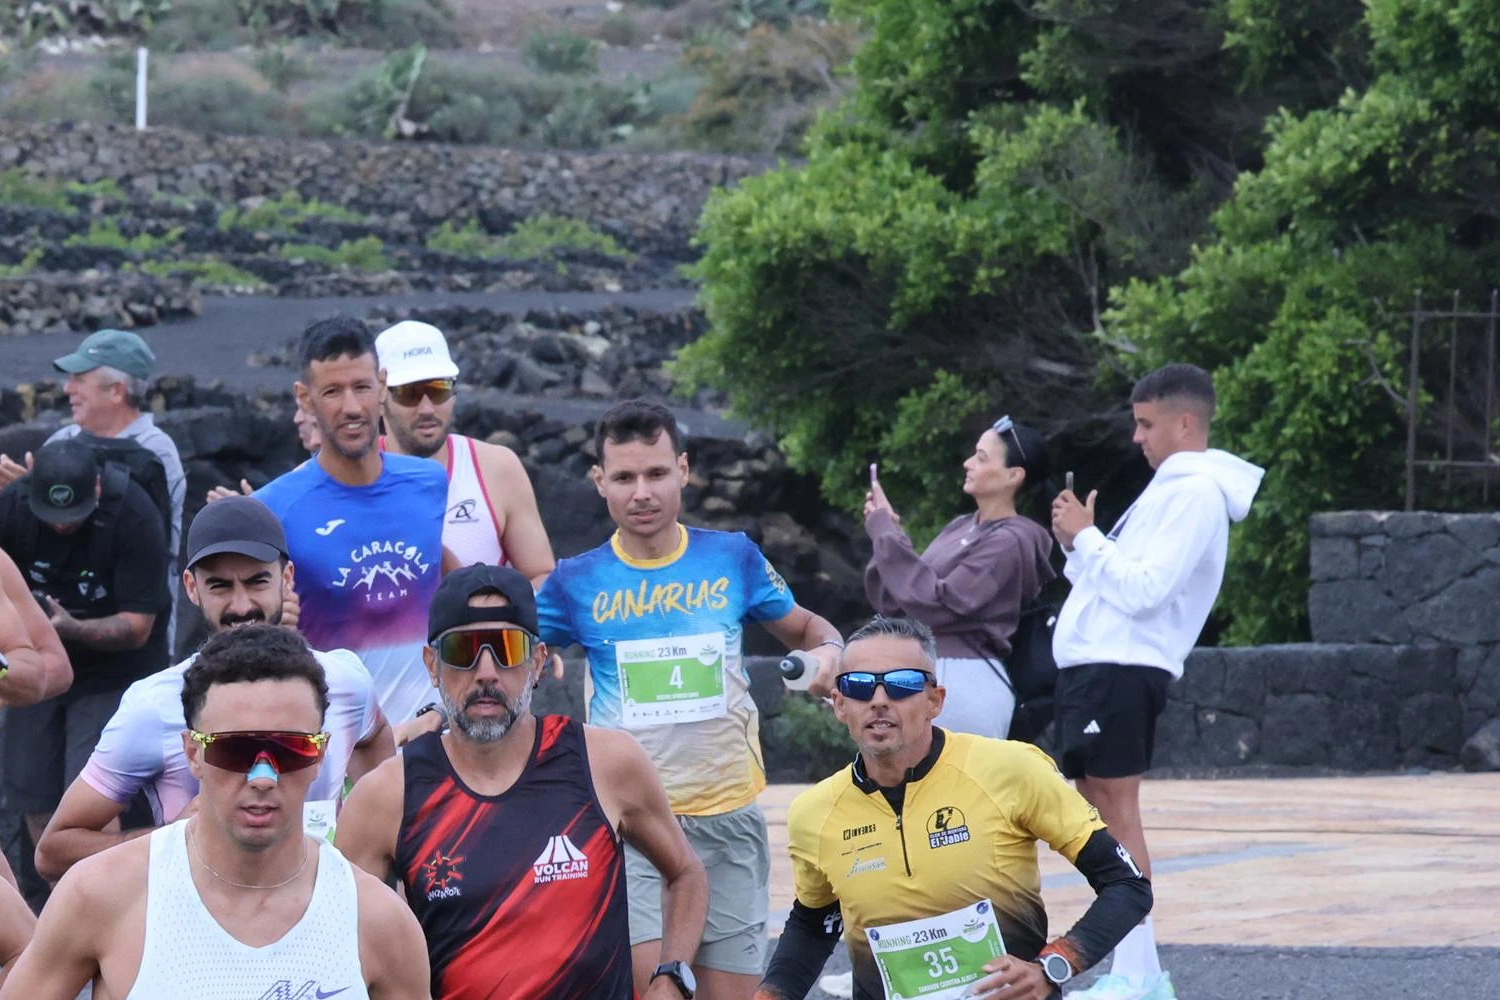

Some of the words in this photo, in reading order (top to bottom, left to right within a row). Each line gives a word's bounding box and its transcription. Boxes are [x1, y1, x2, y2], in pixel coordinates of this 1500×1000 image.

[332, 567, 351, 587] LA
[351, 540, 430, 575] CARACOLA
[365, 589, 408, 602] TEAM
[592, 577, 730, 624] CANARIAS
[658, 647, 671, 658] 23
[672, 646, 687, 657] Km
[669, 664, 684, 690] 4
[930, 838, 940, 848] El
[942, 831, 969, 846] Jable
[533, 860, 589, 876] VOLCAN
[534, 875, 551, 884] RUN
[551, 871, 588, 881] TRAINING
[912, 930, 929, 944] 23
[929, 927, 948, 941] Km
[923, 946, 959, 978] 35
